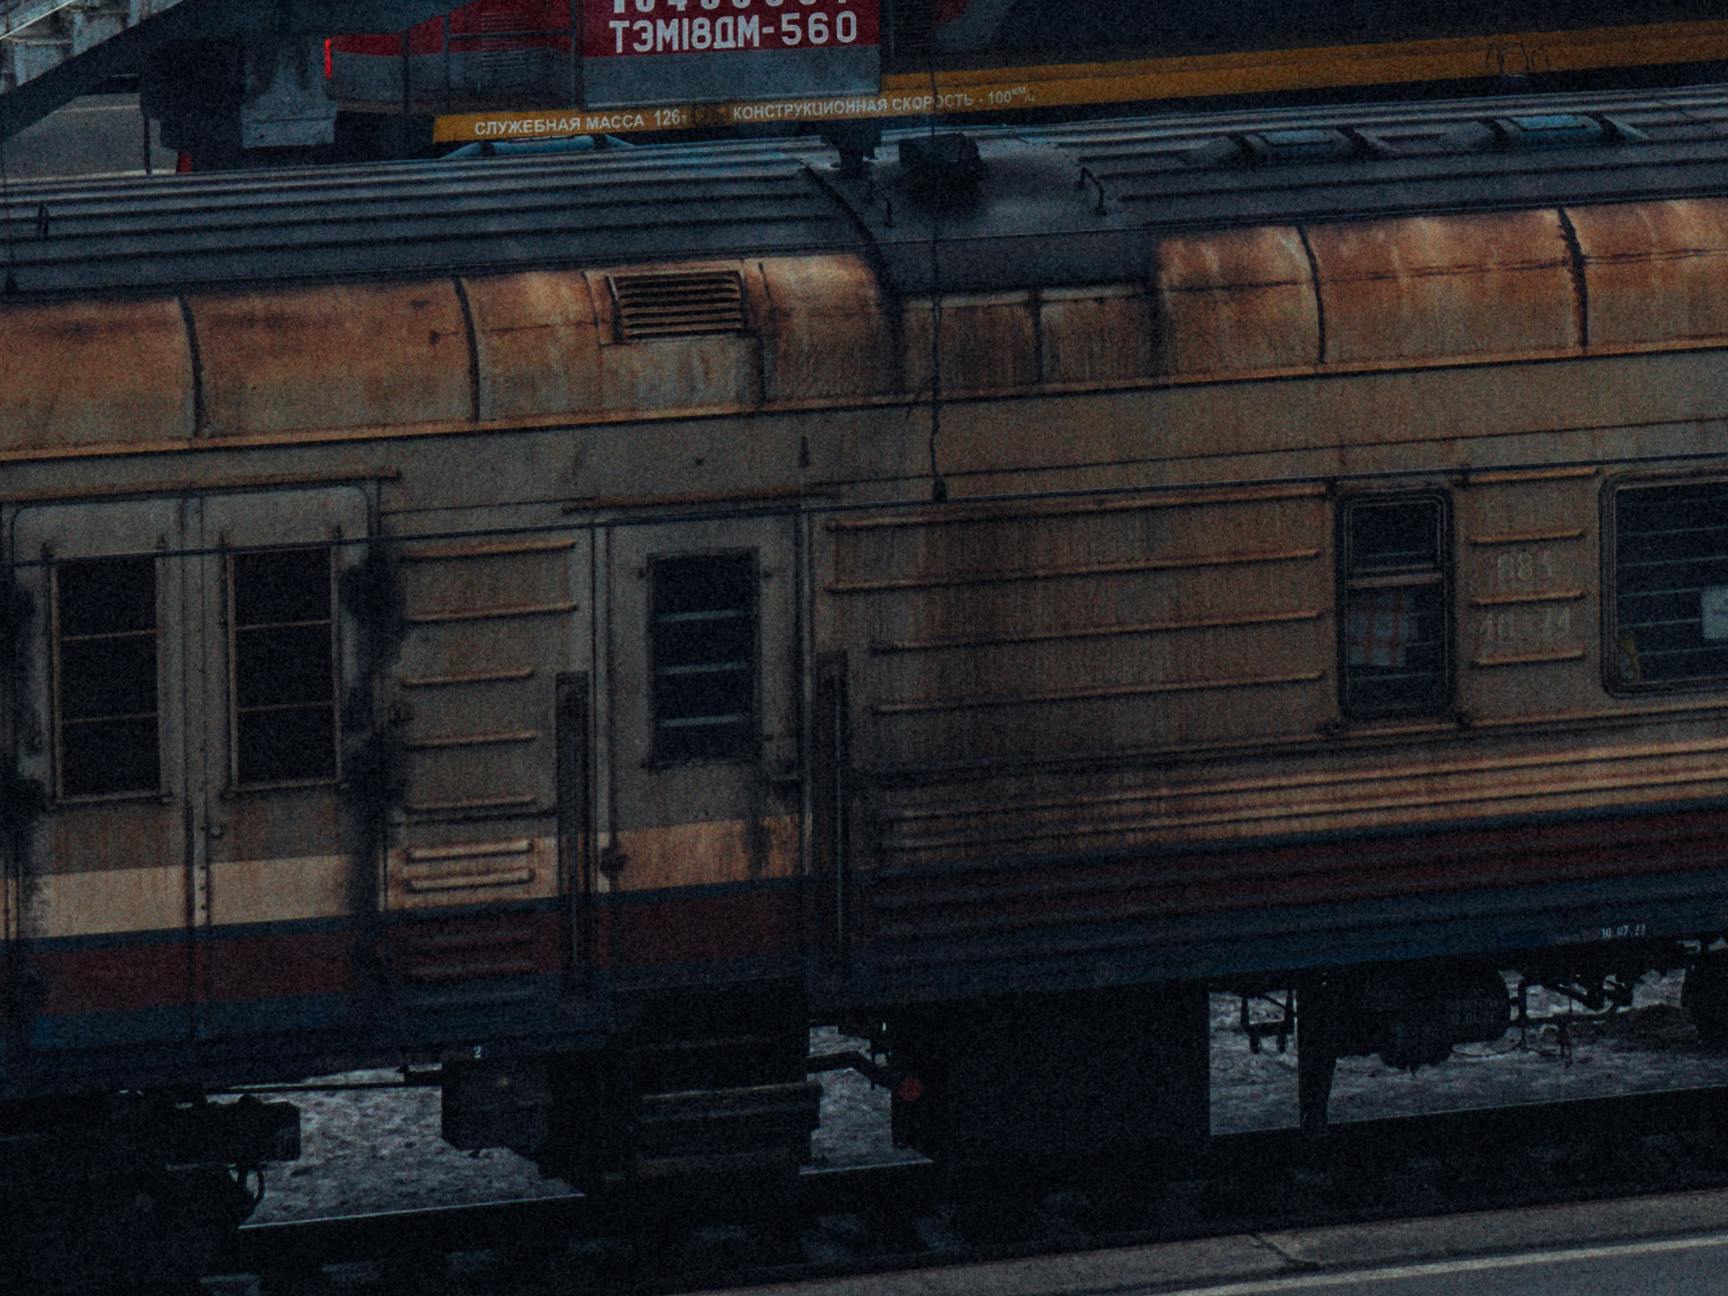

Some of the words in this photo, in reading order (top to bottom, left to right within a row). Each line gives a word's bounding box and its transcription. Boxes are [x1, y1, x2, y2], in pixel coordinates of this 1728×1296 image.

[474, 116, 581, 136] СЛУЖЕБНАЯ
[585, 113, 646, 131] МАССА
[733, 97, 888, 121] КОНСТРУКЦИОННАЯ
[891, 92, 973, 112] СКОРОСТЬ
